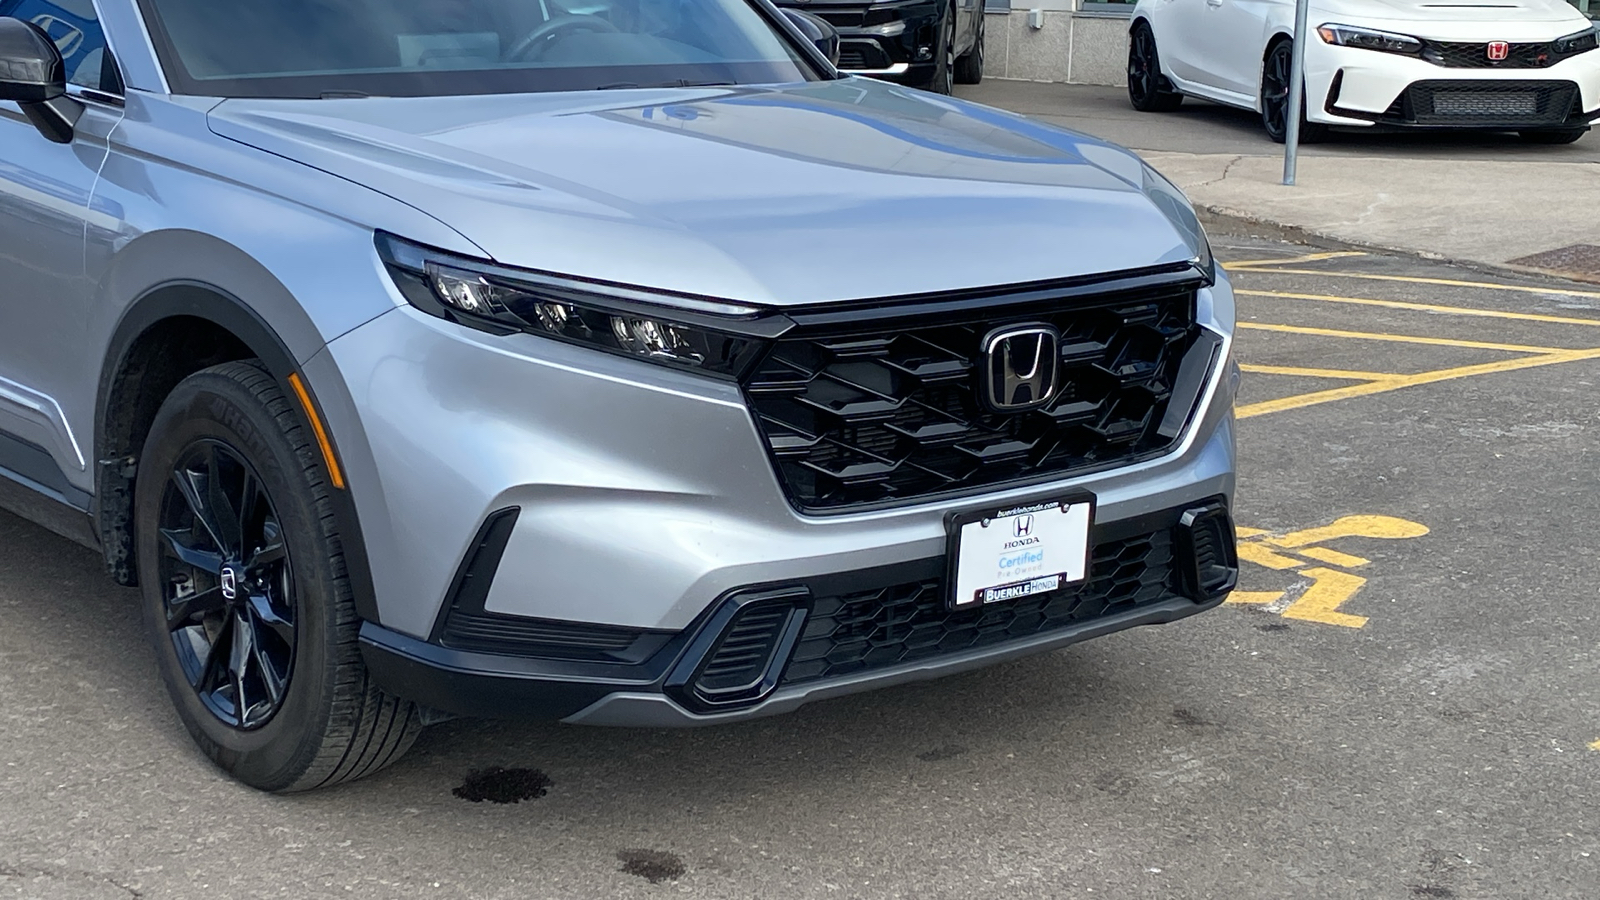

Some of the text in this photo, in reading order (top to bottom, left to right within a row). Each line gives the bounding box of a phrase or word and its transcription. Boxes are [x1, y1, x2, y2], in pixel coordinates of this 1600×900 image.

[997, 502, 1059, 517] buerklehonda.com
[1004, 537, 1040, 549] HONDA
[999, 549, 1043, 568] Certified
[997, 564, 1042, 579] Pre-Owned
